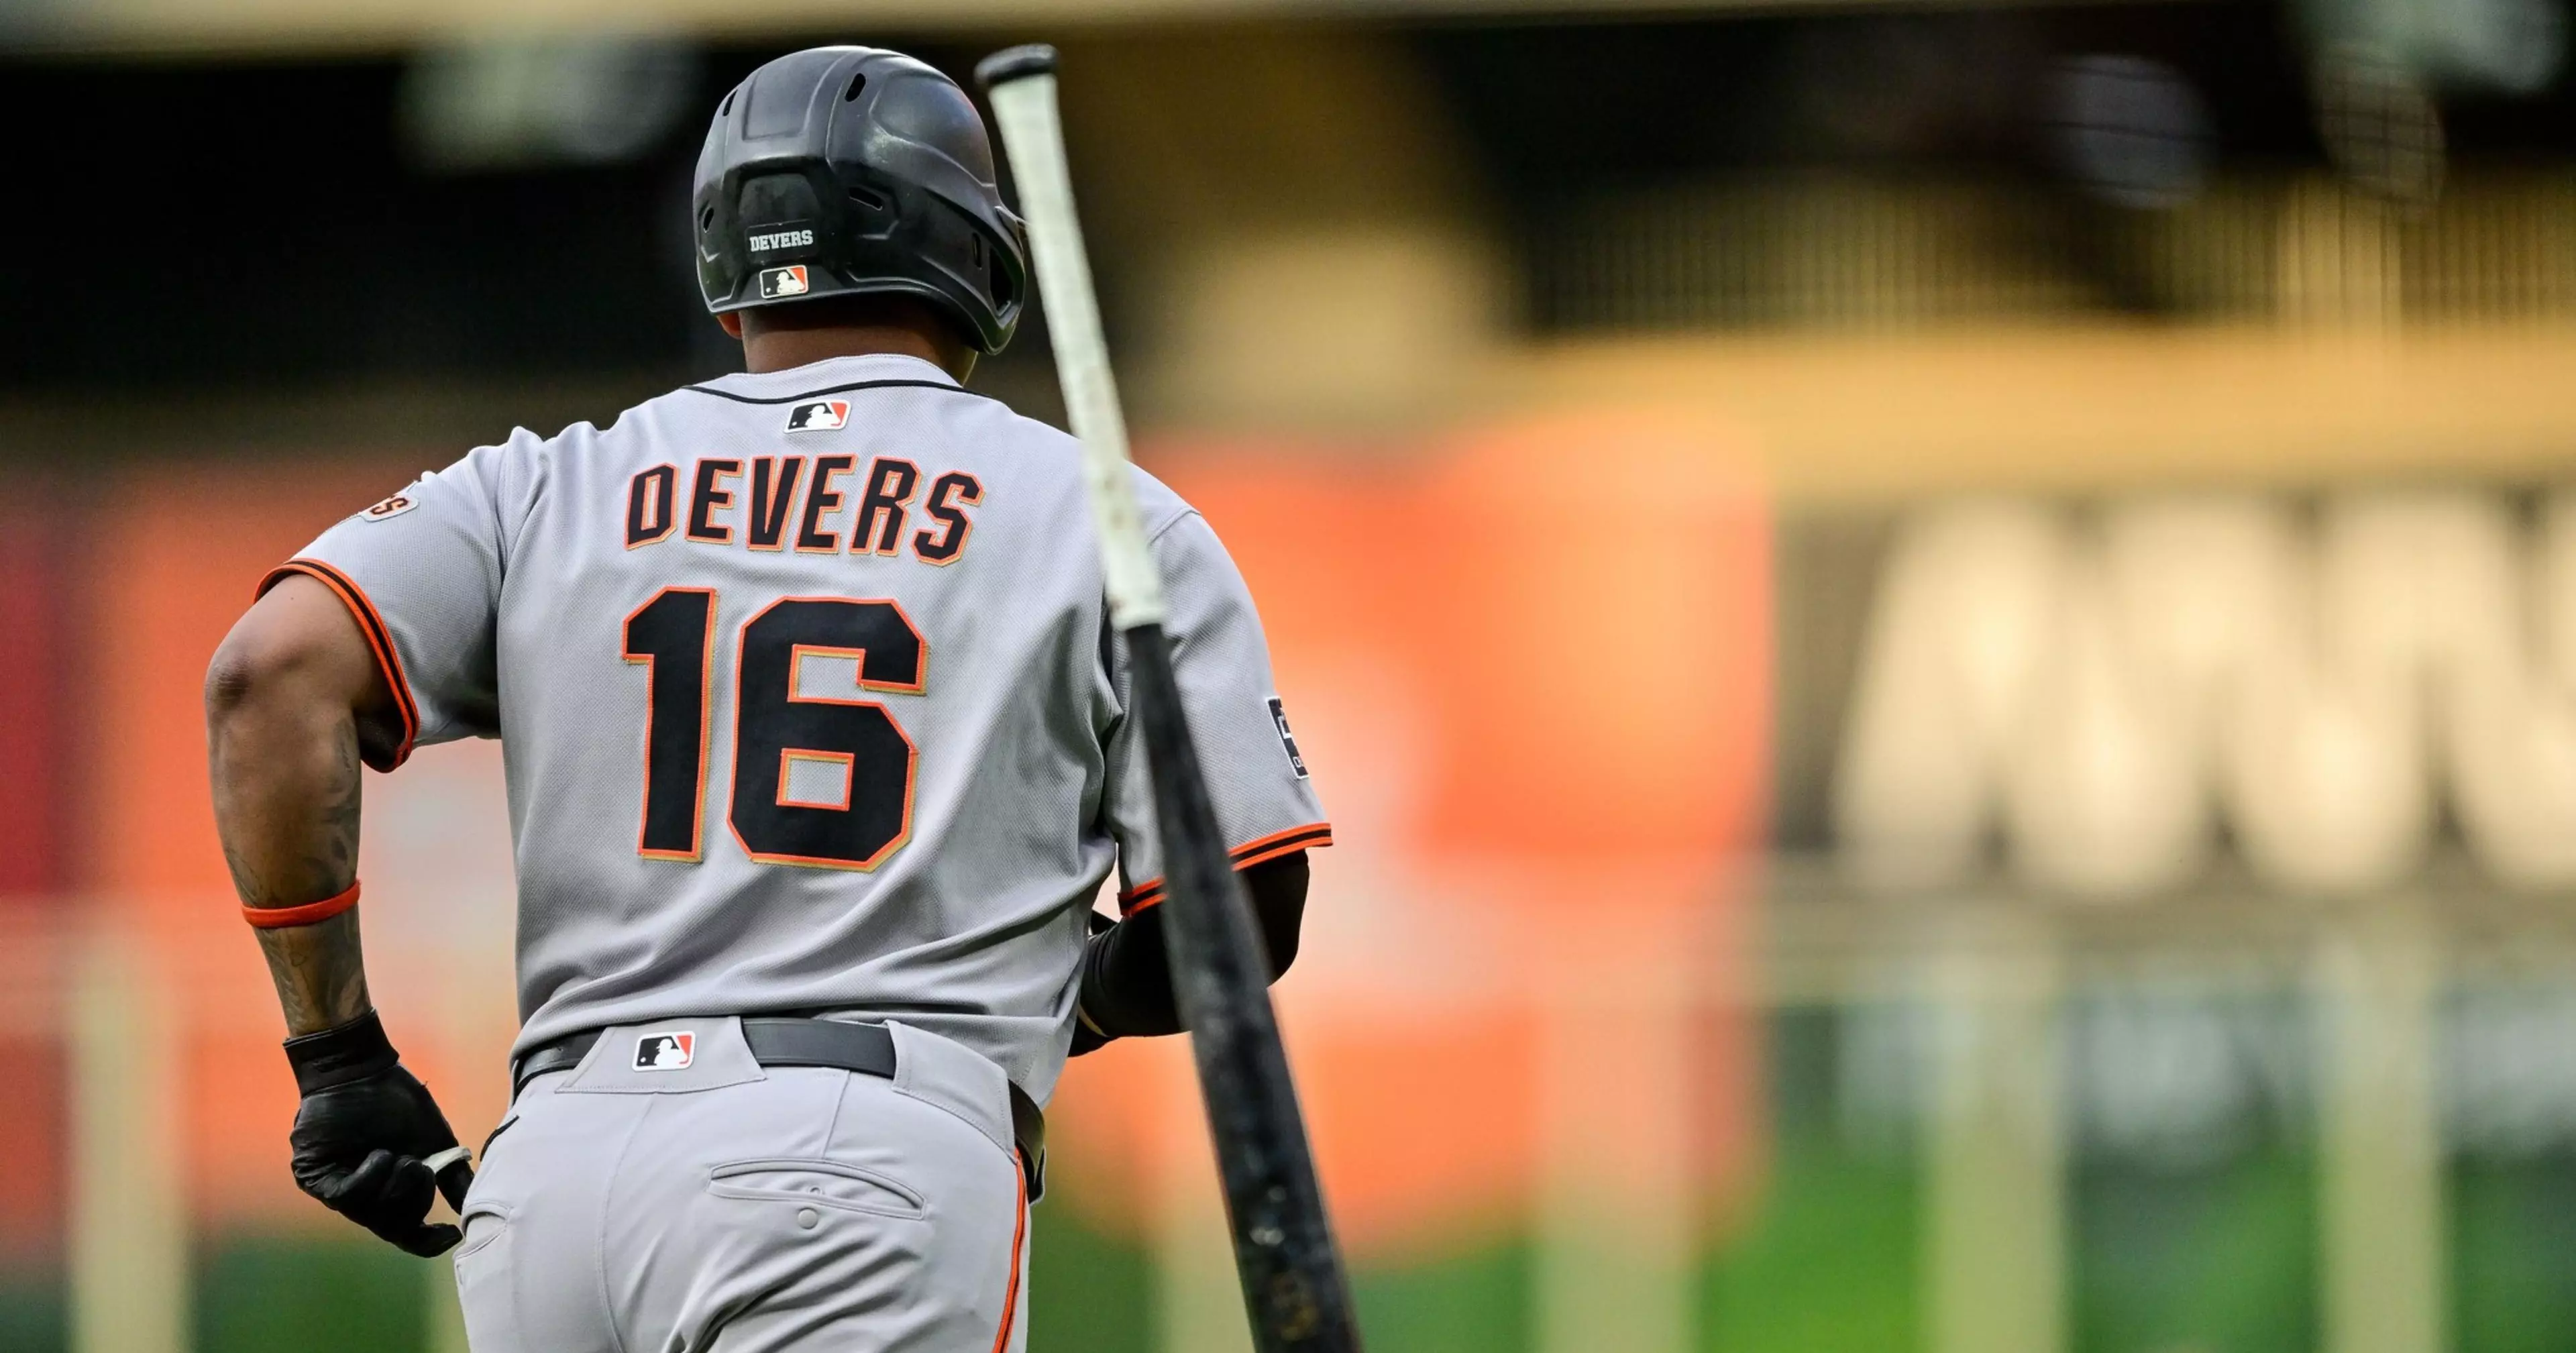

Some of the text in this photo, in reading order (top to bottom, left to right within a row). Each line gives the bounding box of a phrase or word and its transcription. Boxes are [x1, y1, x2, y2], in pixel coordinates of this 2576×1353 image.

[749, 229, 814, 252] DEVERS
[625, 454, 985, 565] DEVERS
[623, 586, 928, 871] 16
